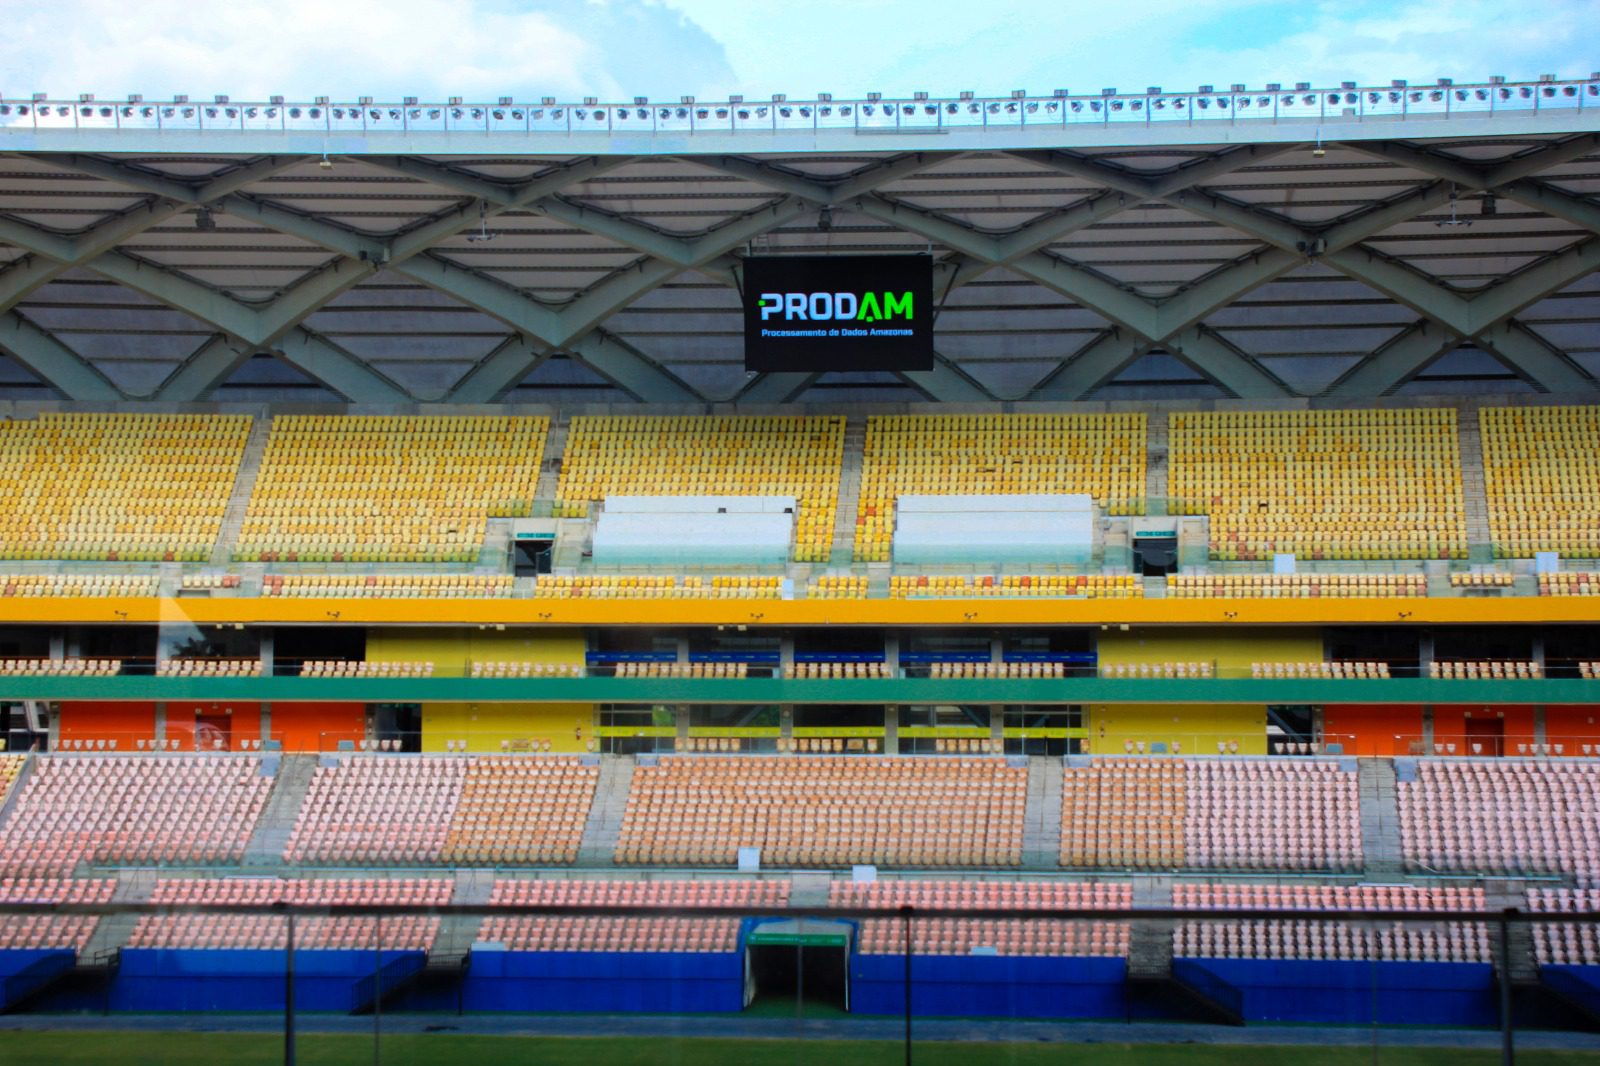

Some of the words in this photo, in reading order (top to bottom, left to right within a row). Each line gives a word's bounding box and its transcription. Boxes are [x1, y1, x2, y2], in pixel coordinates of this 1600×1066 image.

[759, 292, 913, 322] PRODAM
[761, 329, 827, 337] Processamento
[828, 329, 840, 337] de
[841, 328, 868, 337] Dados
[869, 328, 914, 336] Amazonas
